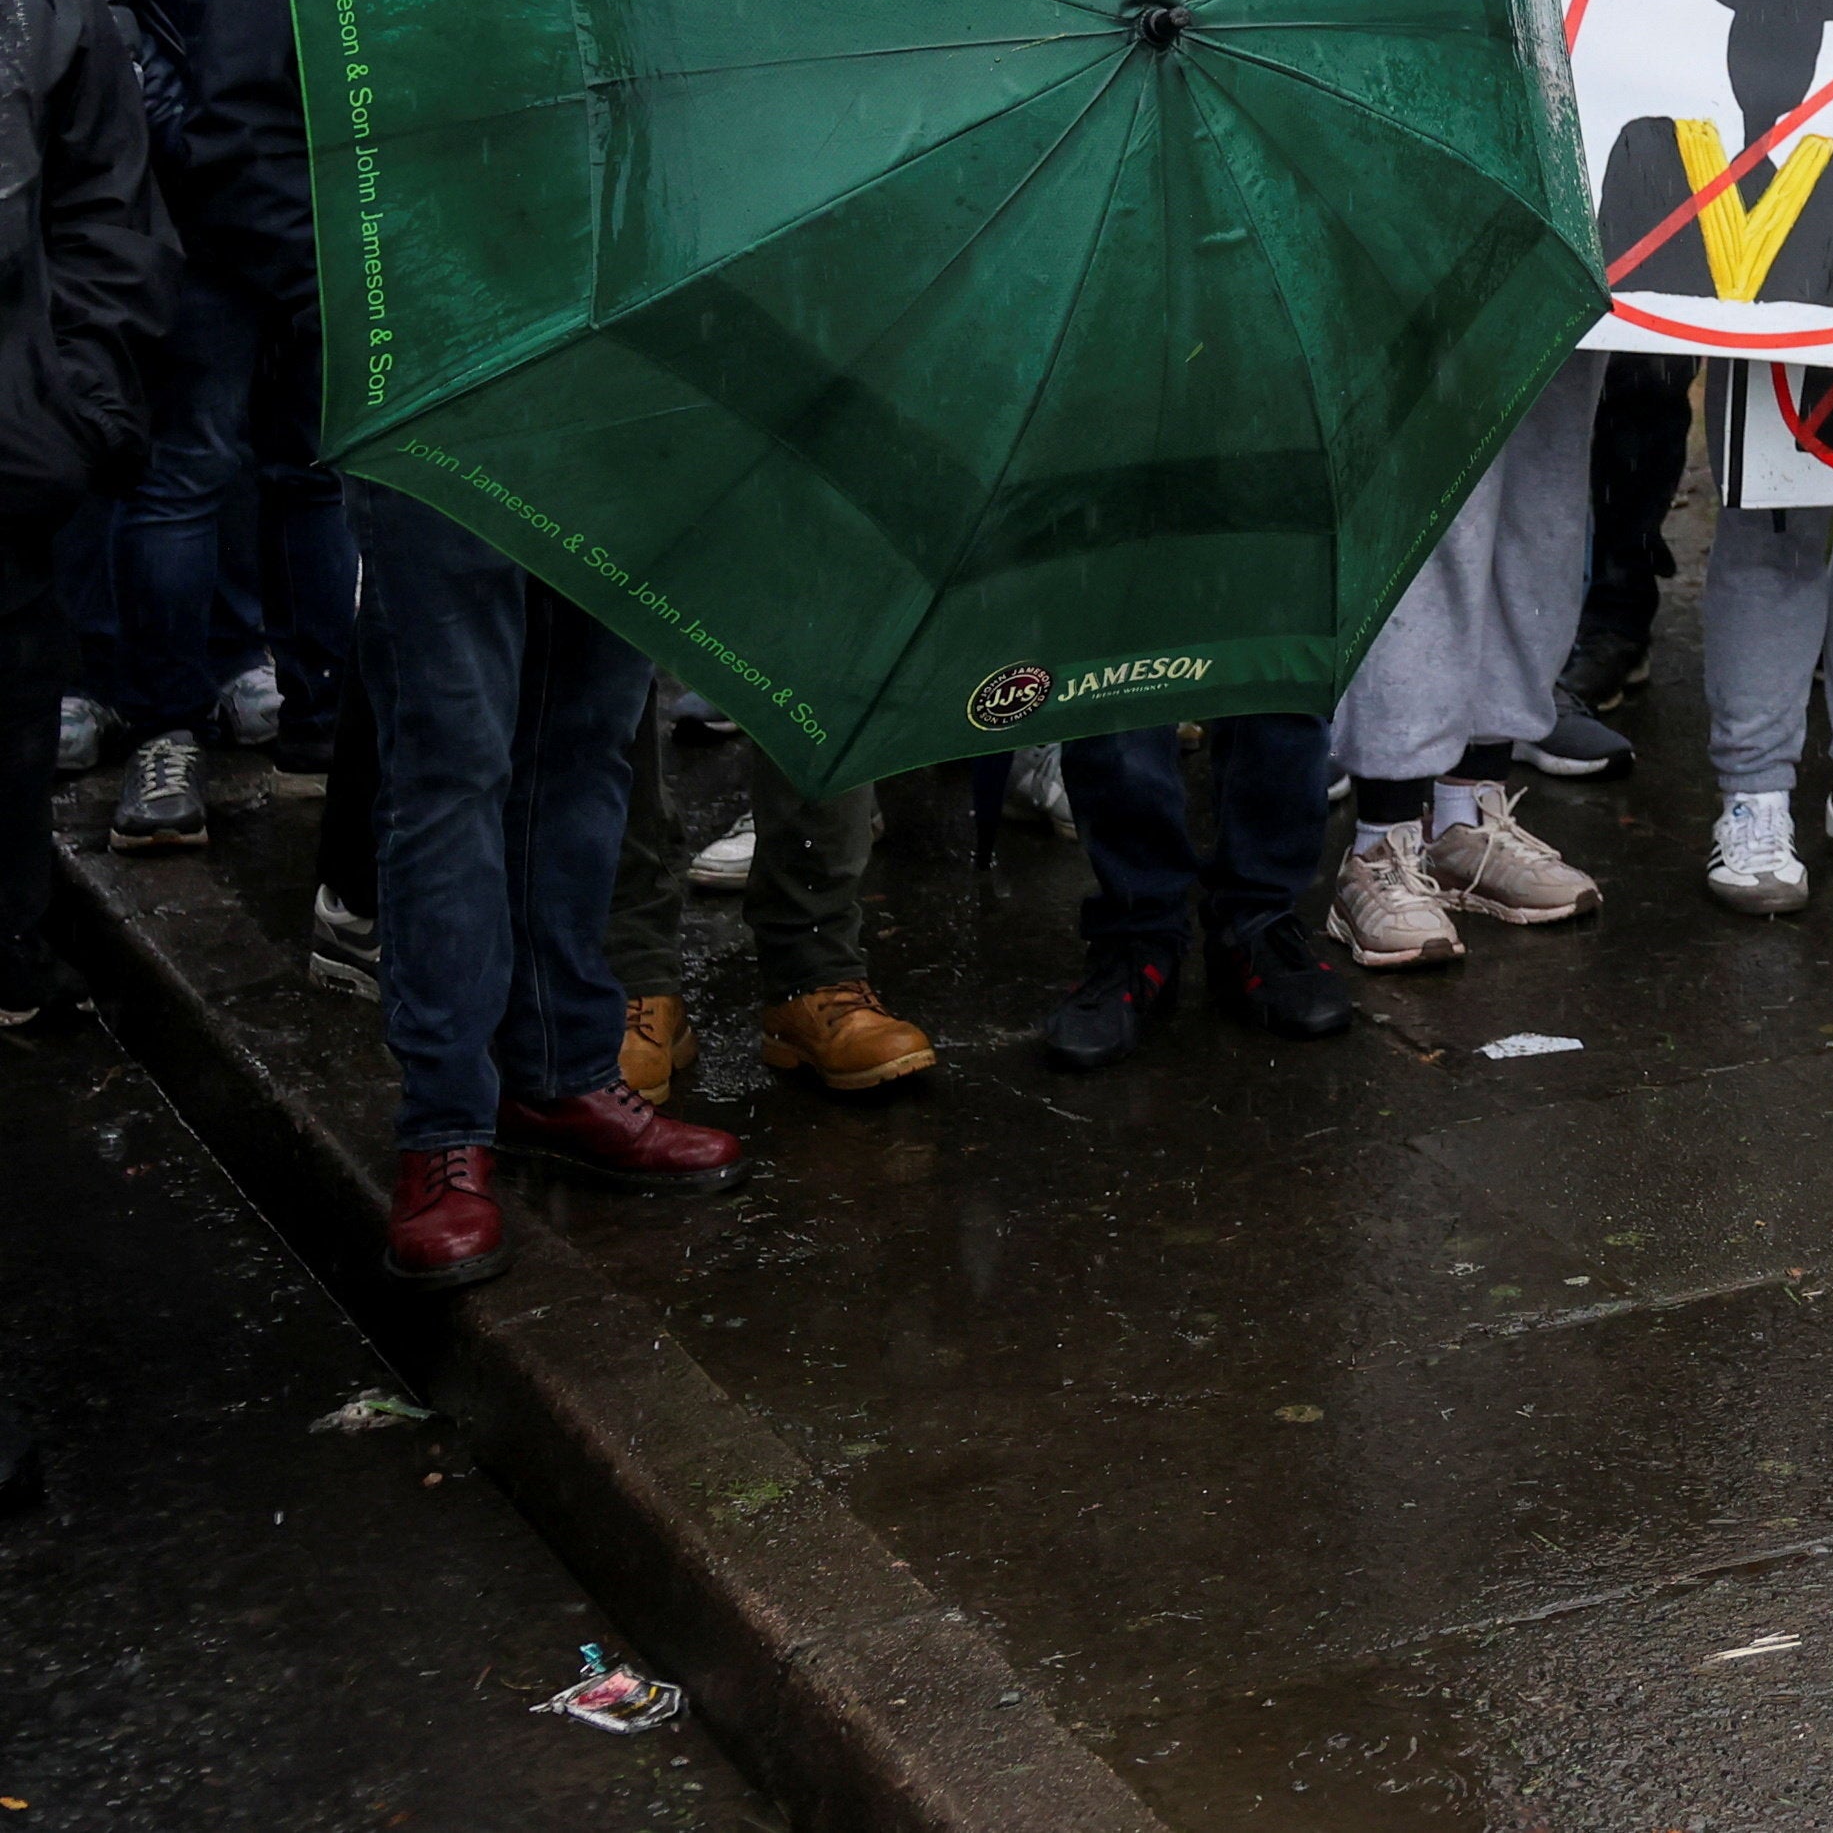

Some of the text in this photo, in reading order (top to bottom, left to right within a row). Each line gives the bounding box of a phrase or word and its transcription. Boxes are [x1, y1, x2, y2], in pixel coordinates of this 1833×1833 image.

[346, 63, 369, 83] &
[349, 86, 374, 139] Son
[355, 145, 381, 204] John
[360, 210, 386, 321] Jameson
[369, 327, 393, 348] &
[367, 352, 393, 407] Son
[1344, 615, 1373, 664] John
[1440, 469, 1467, 508] Son
[1466, 424, 1498, 470] John
[396, 438, 828, 746] John Jameson & Son John Jameson & Son
[981, 666, 1052, 698] JOHN JAMESON
[985, 682, 1039, 709] JJ&S
[1057, 656, 1213, 703] JAMESON
[1123, 682, 1170, 696] WHISKEY
[979, 711, 999, 725] SON
[1002, 693, 1046, 724] LIMITED
